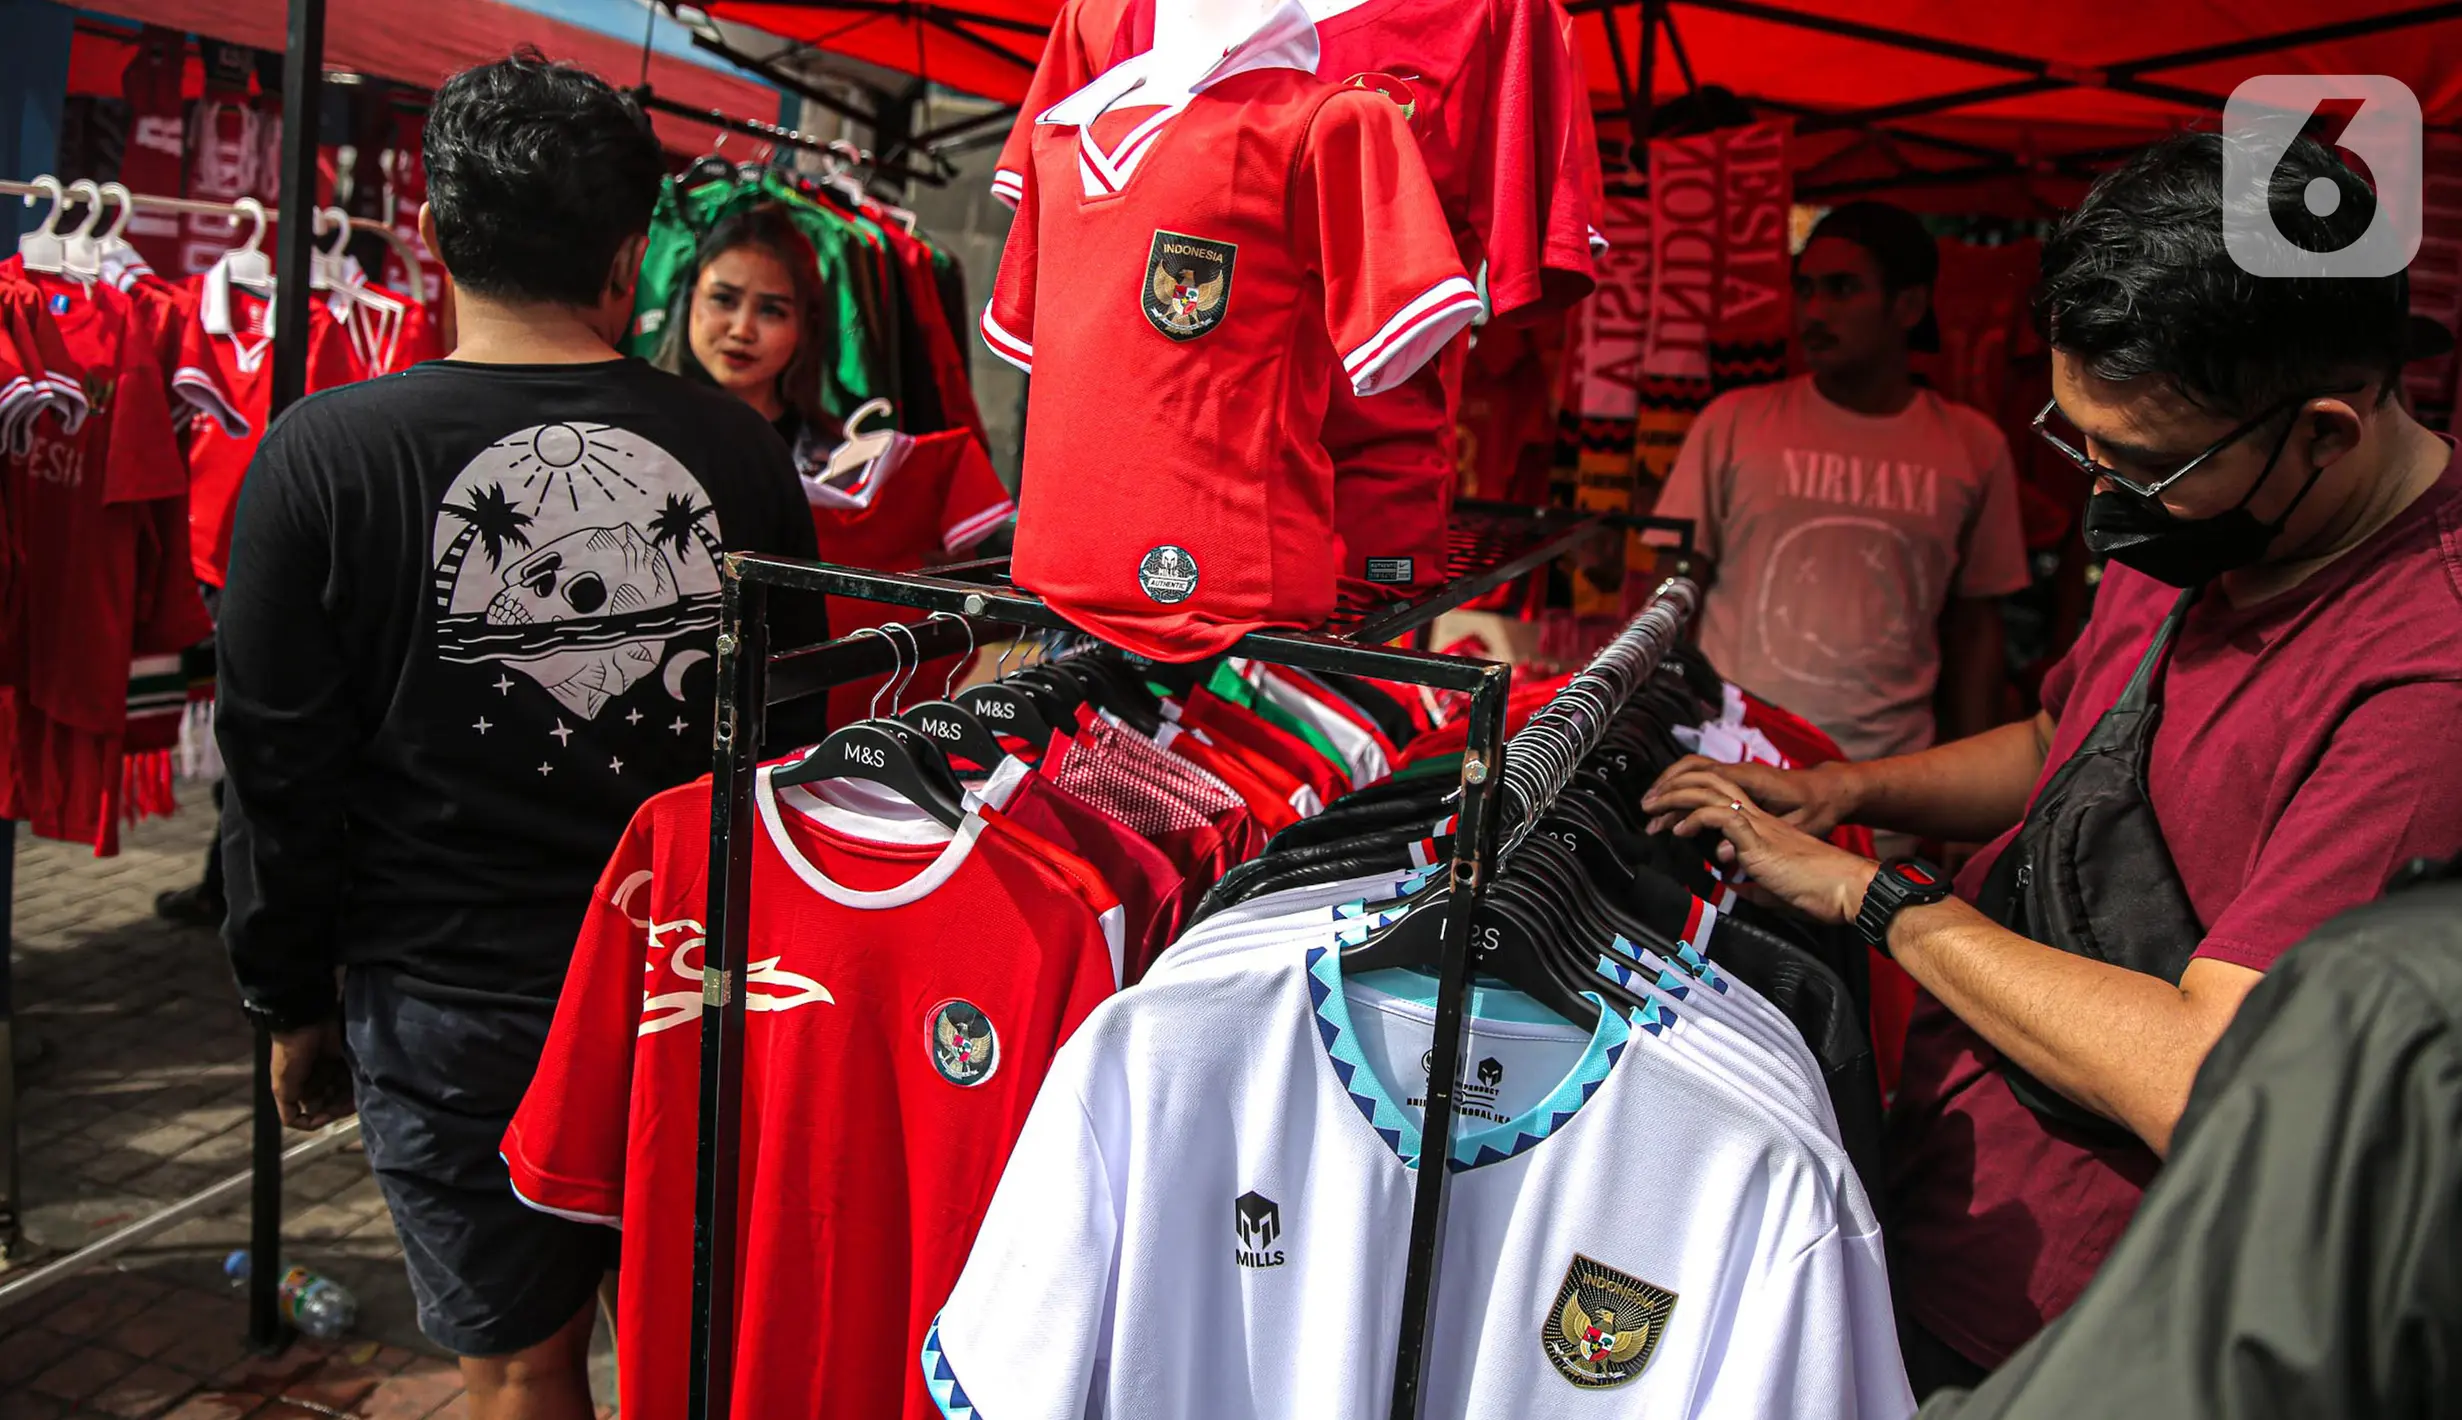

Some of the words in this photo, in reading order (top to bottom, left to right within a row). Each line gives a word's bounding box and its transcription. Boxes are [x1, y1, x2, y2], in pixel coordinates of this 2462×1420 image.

[1162, 243, 1224, 263] INDONESIA
[1775, 448, 1938, 517] NIRVANA
[1150, 580, 1187, 590] AUTHENTIC
[975, 699, 1015, 720] M&S
[921, 717, 962, 741] M&S
[844, 742, 885, 768] M&S
[1235, 1248, 1285, 1268] MILLS
[1583, 1273, 1655, 1312] INDONESIA
